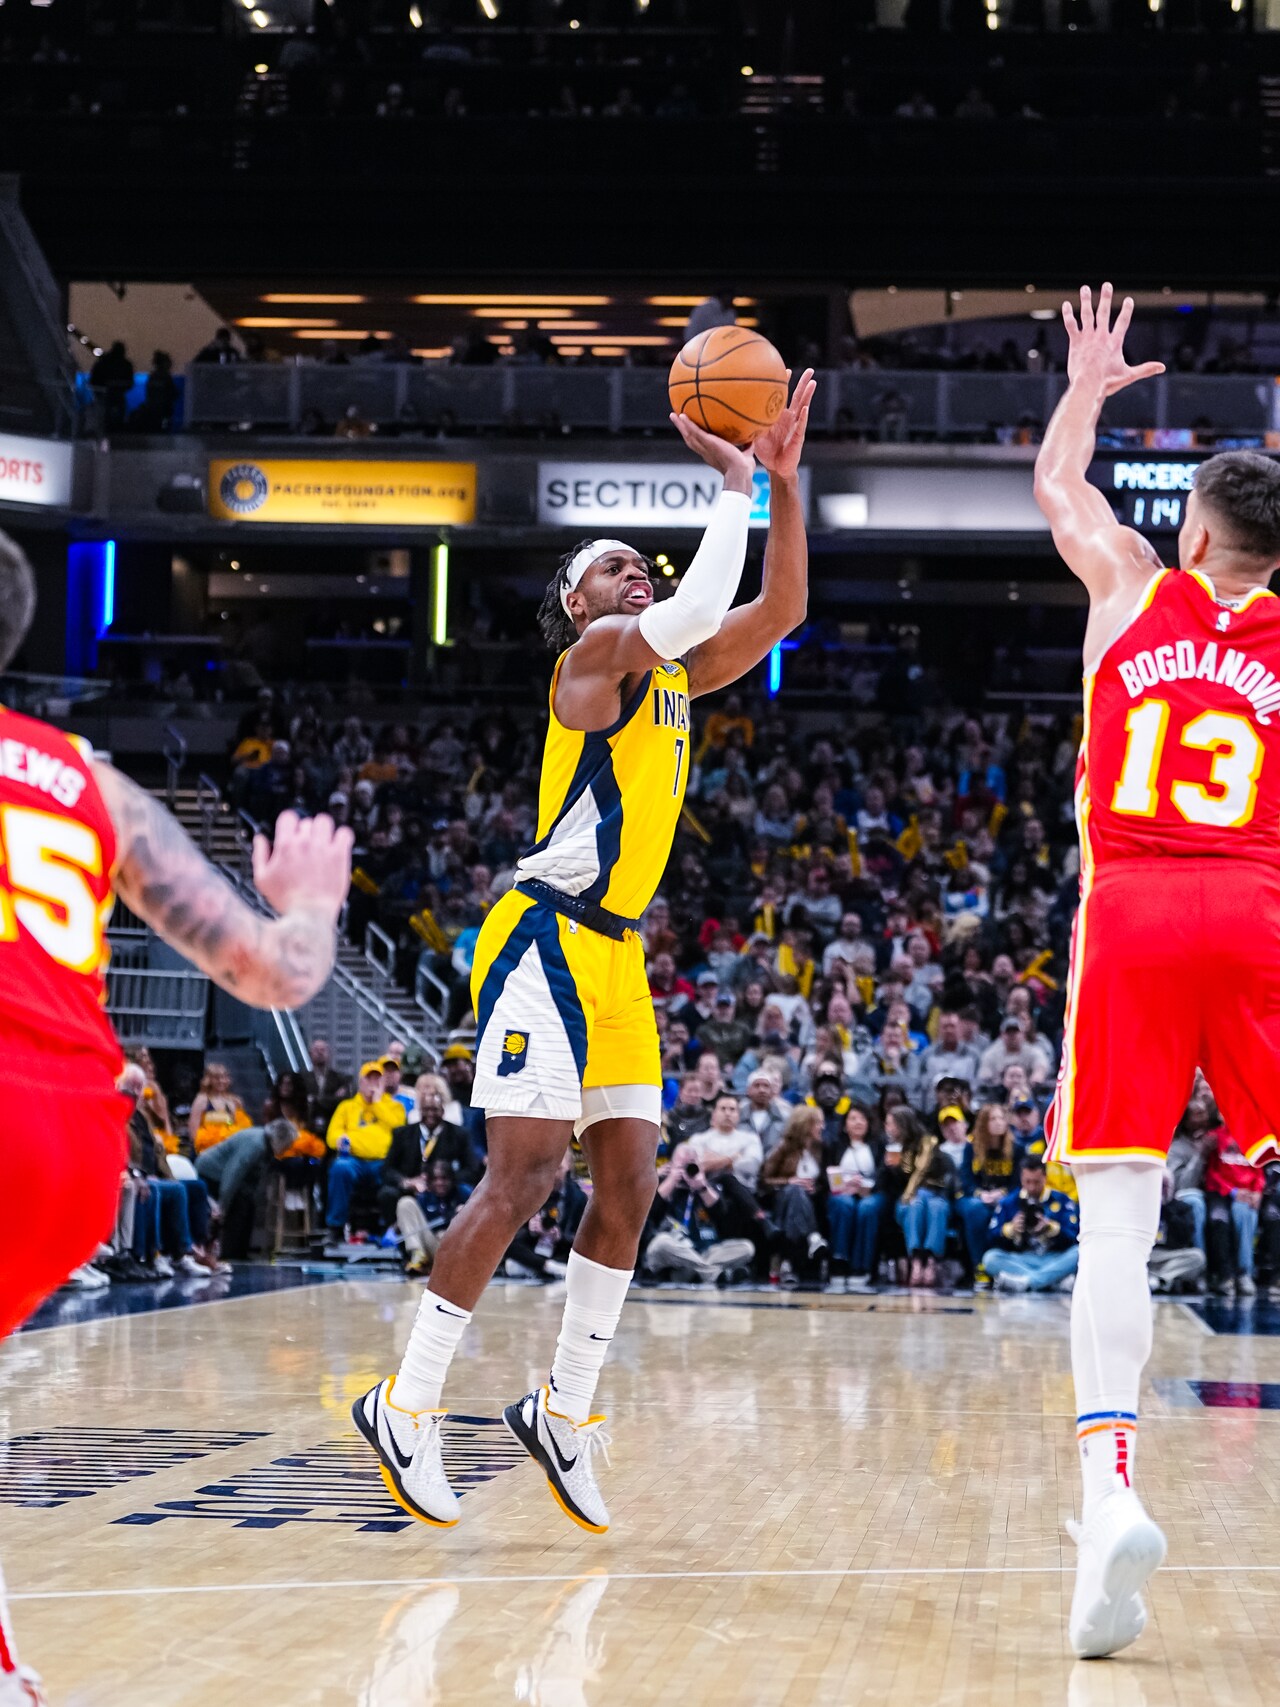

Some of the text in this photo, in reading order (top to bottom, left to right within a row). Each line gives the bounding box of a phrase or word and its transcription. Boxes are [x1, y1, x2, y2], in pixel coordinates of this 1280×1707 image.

[547, 480, 716, 509] SECTION
[1114, 462, 1200, 490] PACERS
[0, 737, 87, 808] EWS
[674, 738, 685, 797] 7
[1111, 697, 1266, 828] 13
[0, 801, 103, 975] 5
